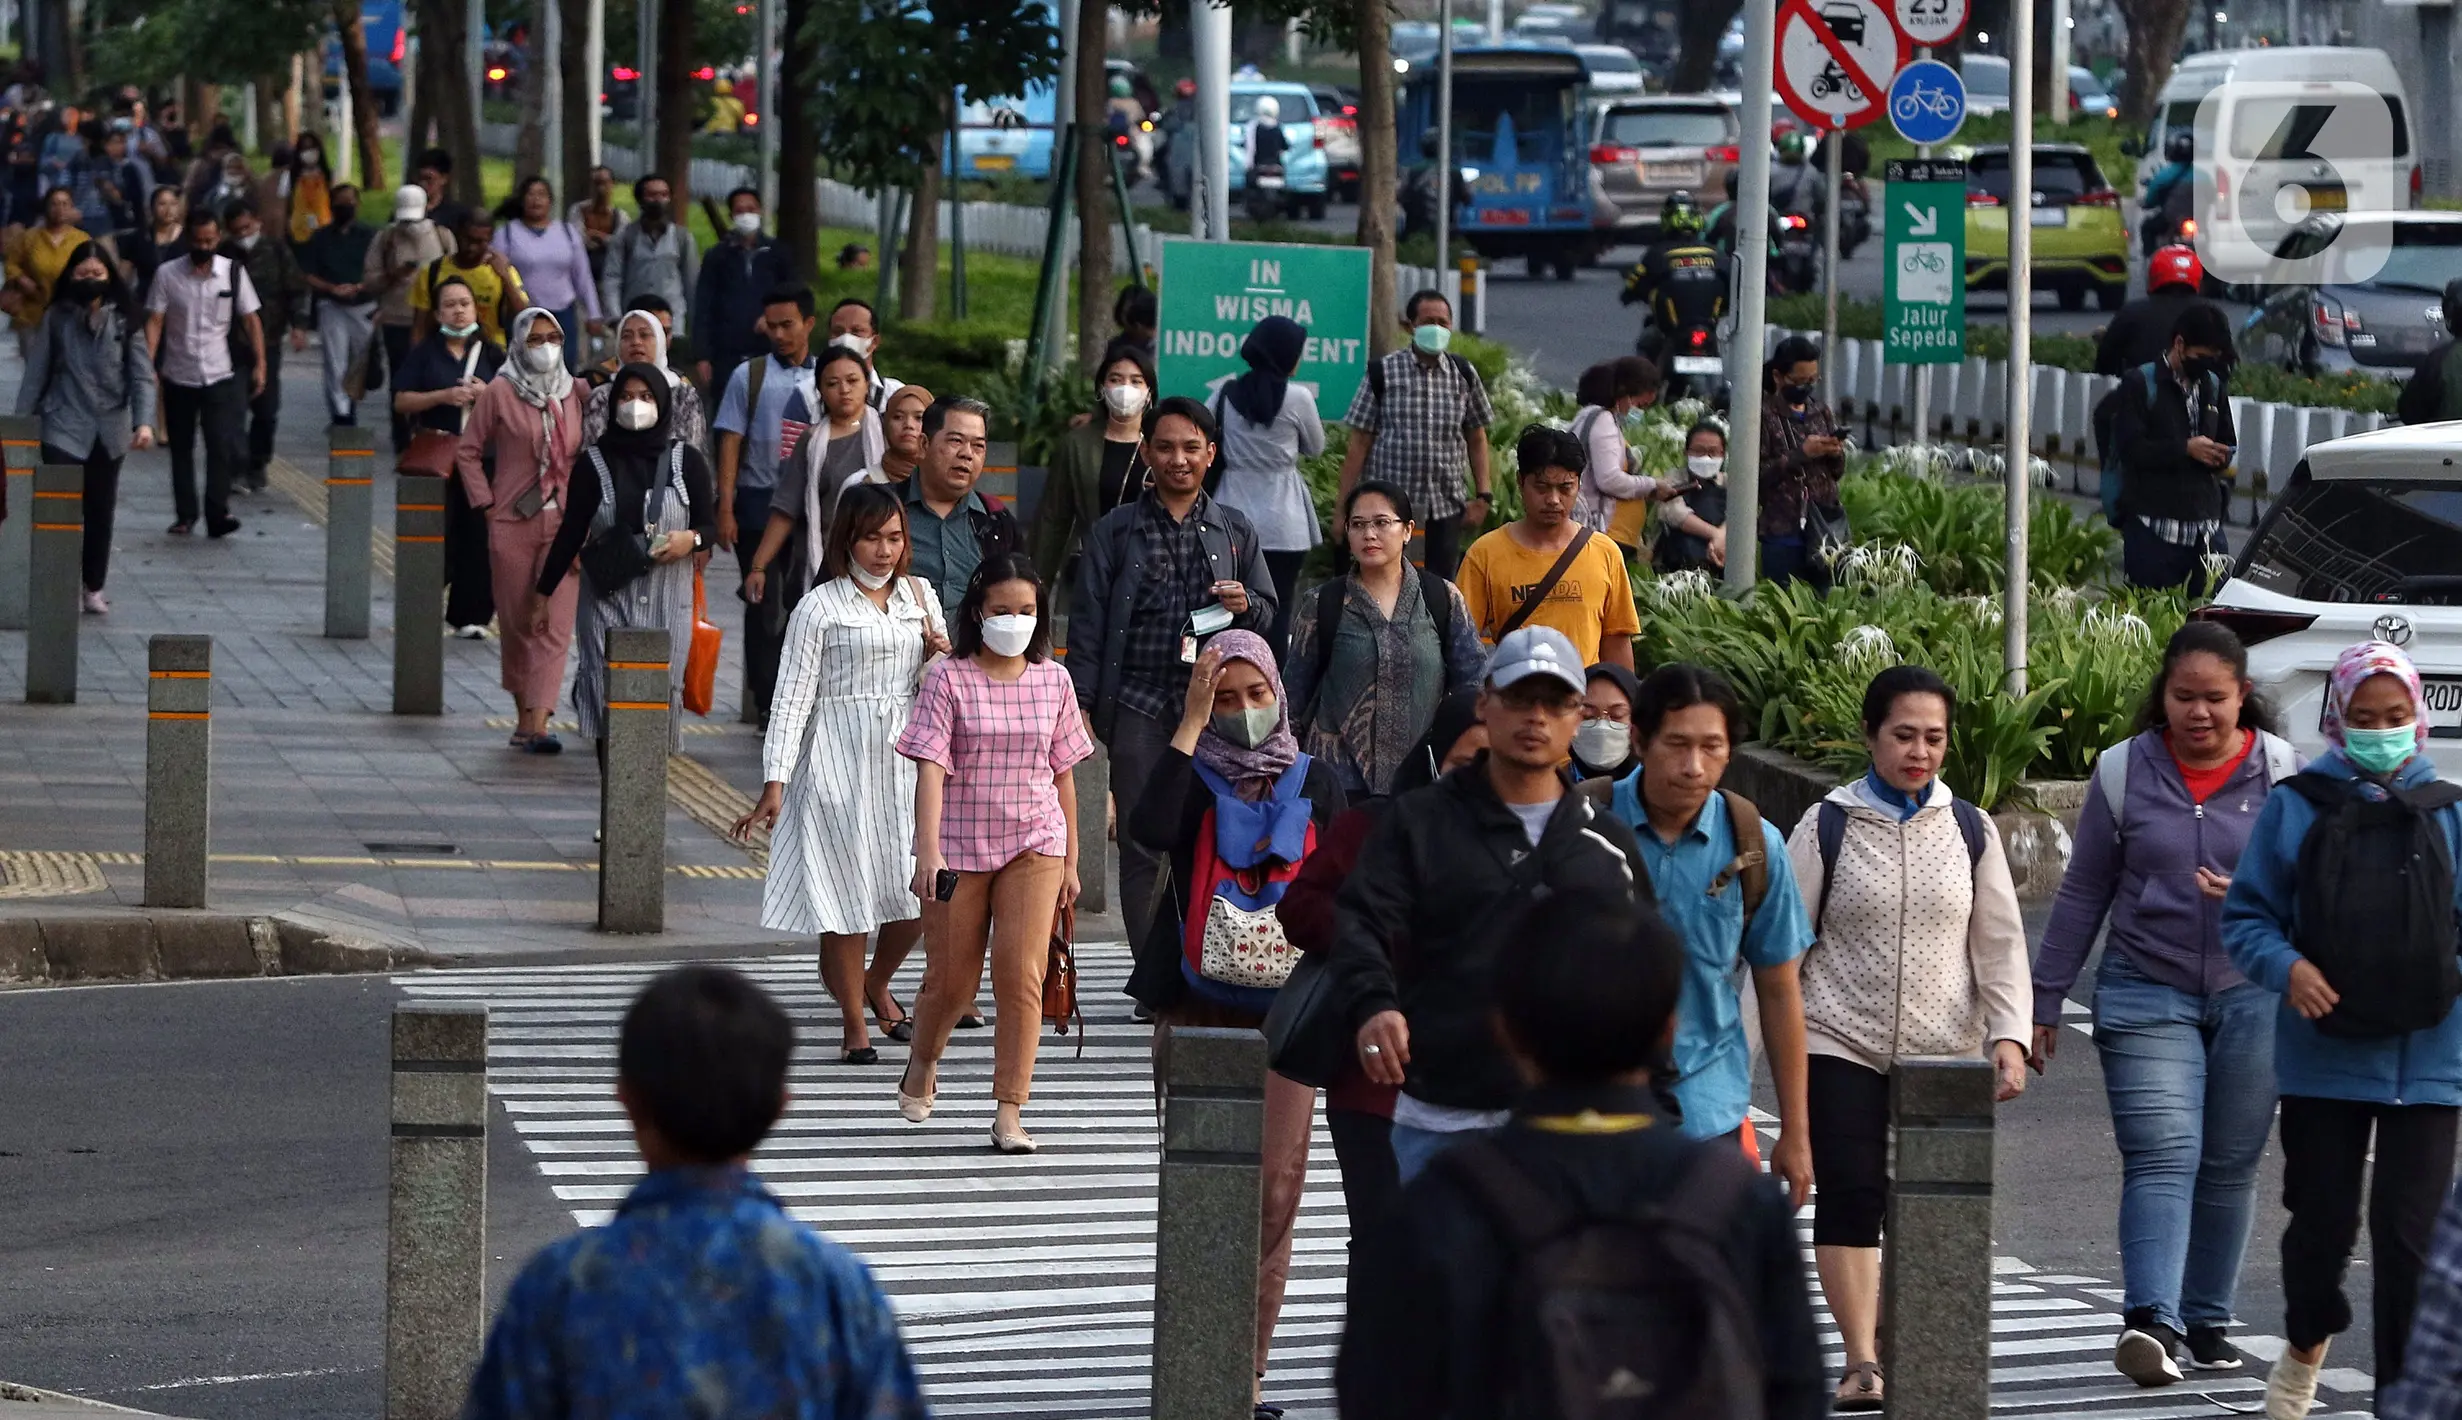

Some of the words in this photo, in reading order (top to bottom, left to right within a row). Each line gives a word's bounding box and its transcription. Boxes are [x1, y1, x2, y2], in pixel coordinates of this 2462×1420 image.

[1251, 259, 1282, 285] IN
[1215, 295, 1315, 326] WISMA
[1900, 306, 1949, 327] Jalur
[1164, 329, 1361, 365] INDOENT
[1889, 326, 1958, 353] Sepeda
